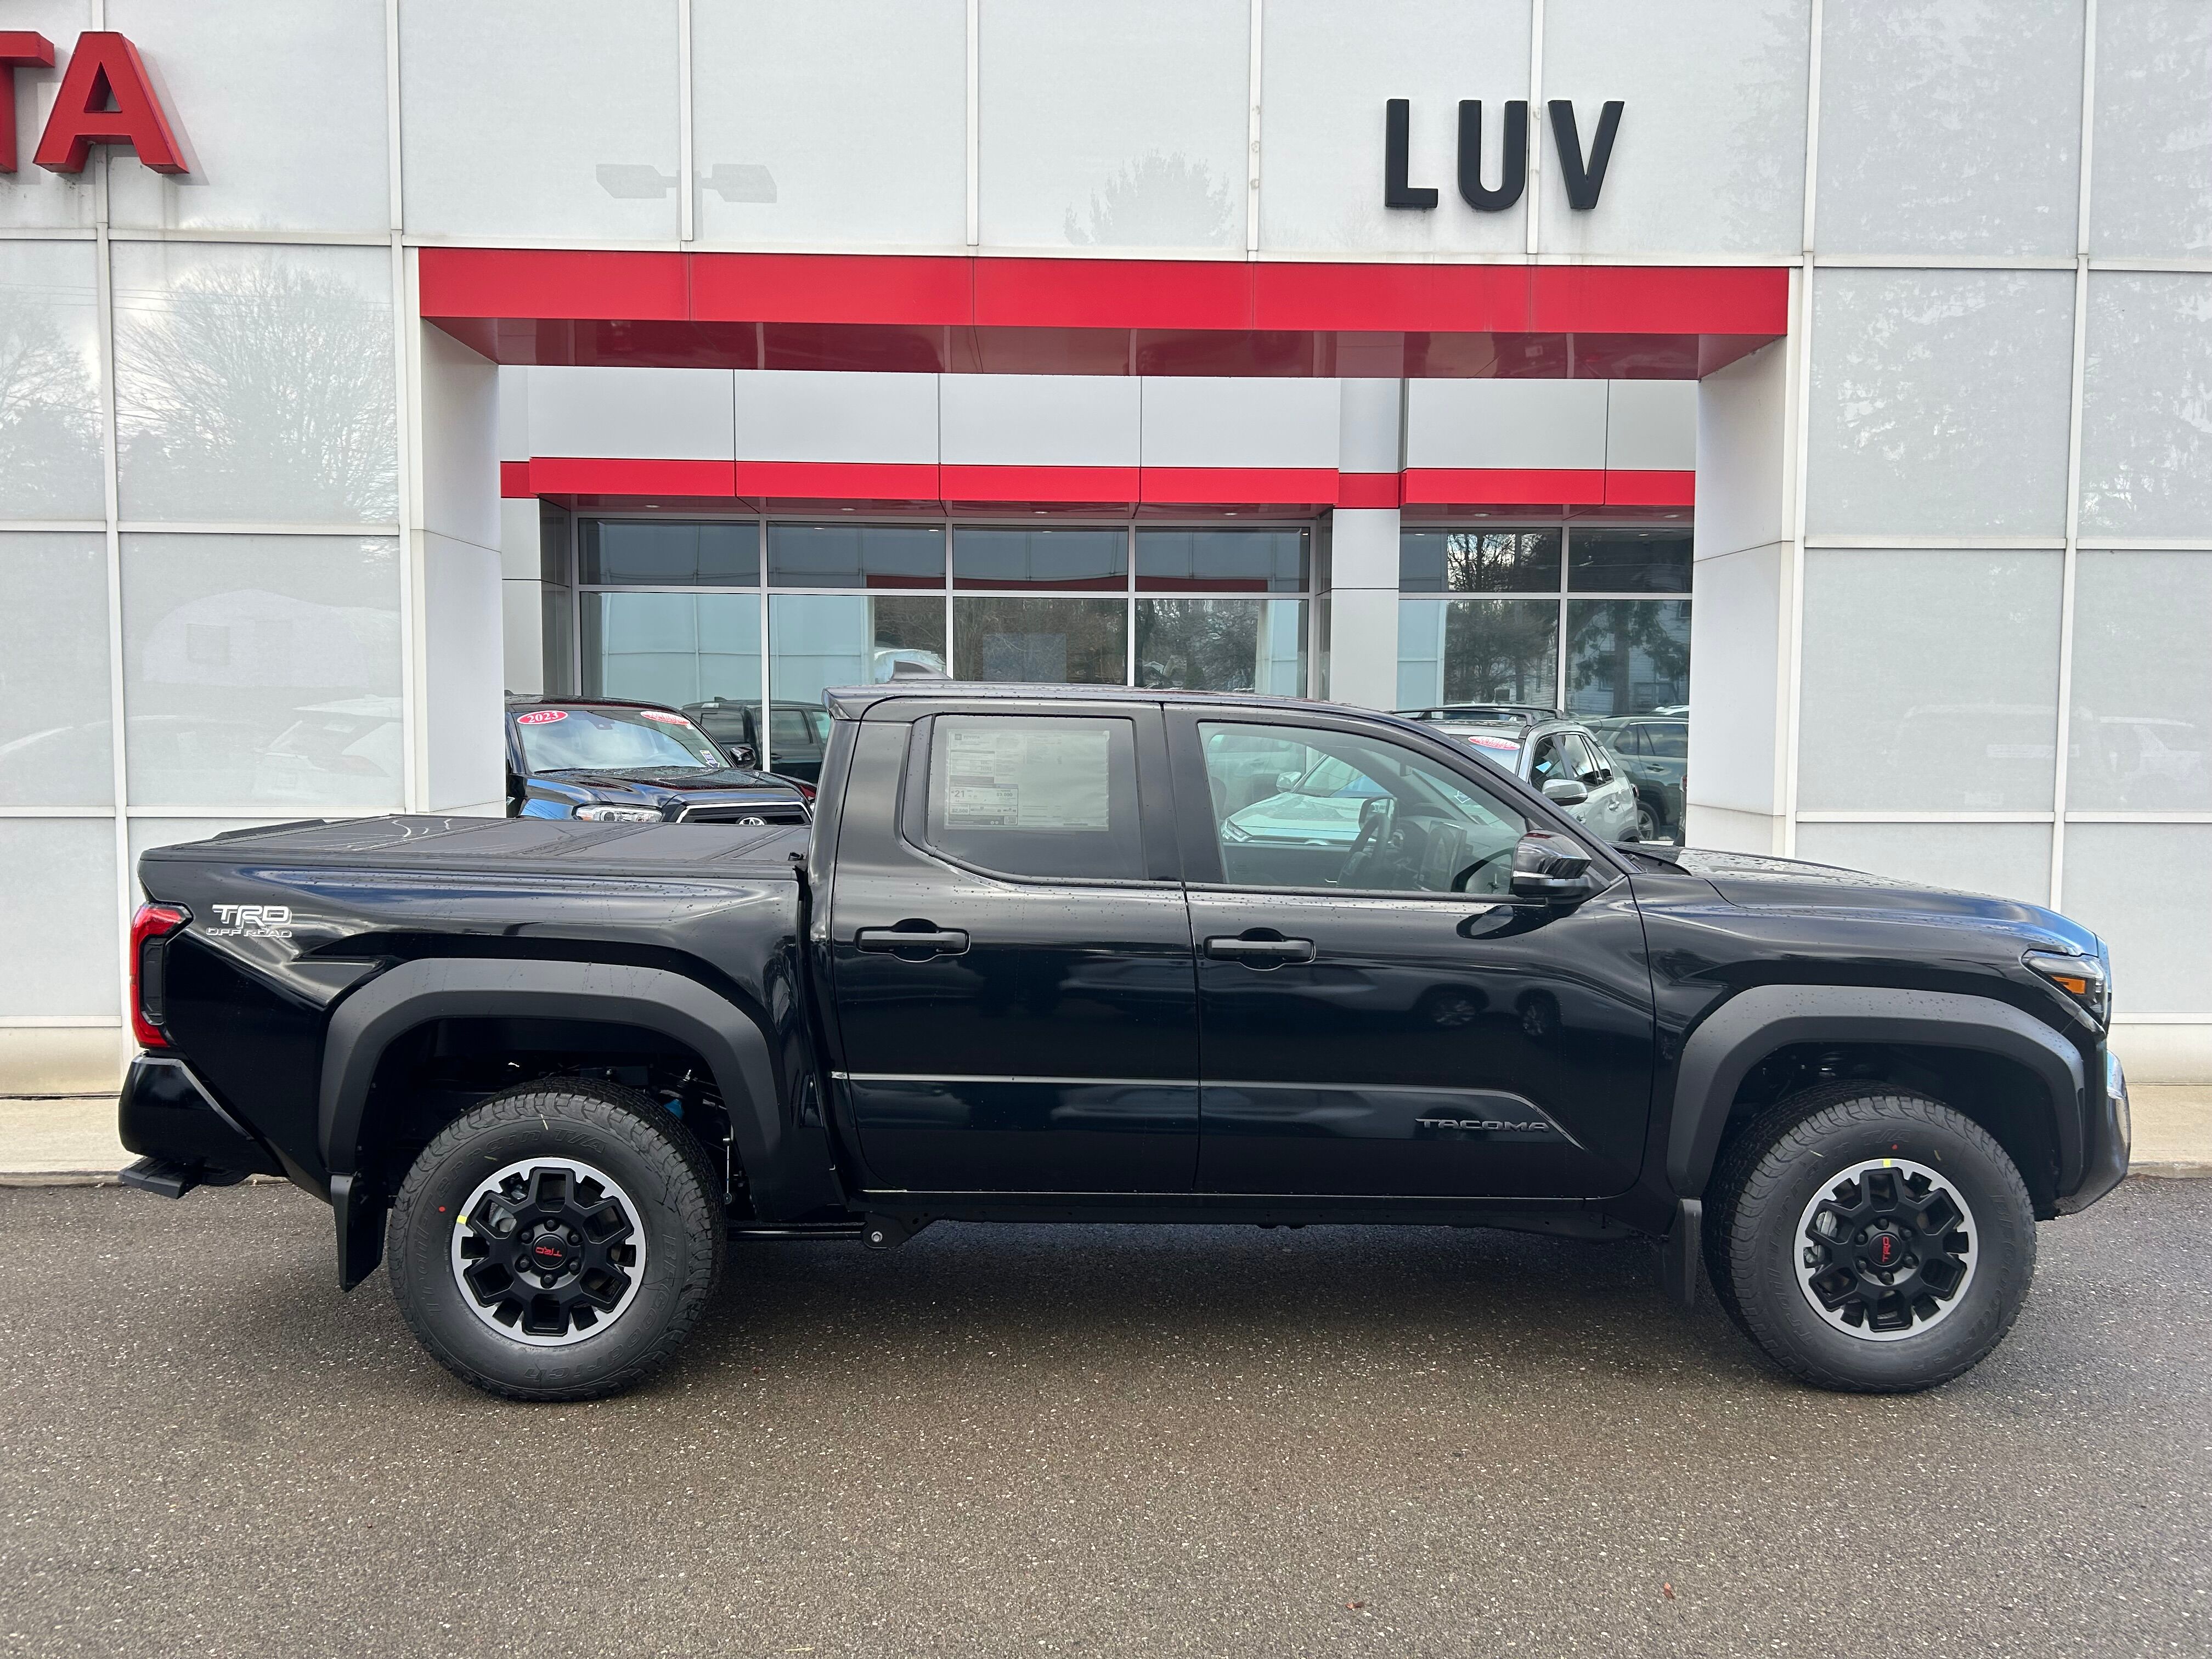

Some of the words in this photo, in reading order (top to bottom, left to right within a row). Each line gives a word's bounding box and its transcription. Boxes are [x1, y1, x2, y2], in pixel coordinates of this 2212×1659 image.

[1384, 98, 1625, 212] LUV
[527, 712, 559, 723] 2023
[954, 789, 965, 798] 21
[212, 904, 292, 929] TRD
[206, 927, 242, 936] OFF
[243, 928, 292, 938] ROAD
[1414, 1118, 1550, 1132] TACOMA
[553, 1127, 606, 1154] T/A
[535, 1246, 562, 1257] TRD
[1882, 1237, 1891, 1262] TRD
[524, 1233, 678, 1383] BFGoodrich
